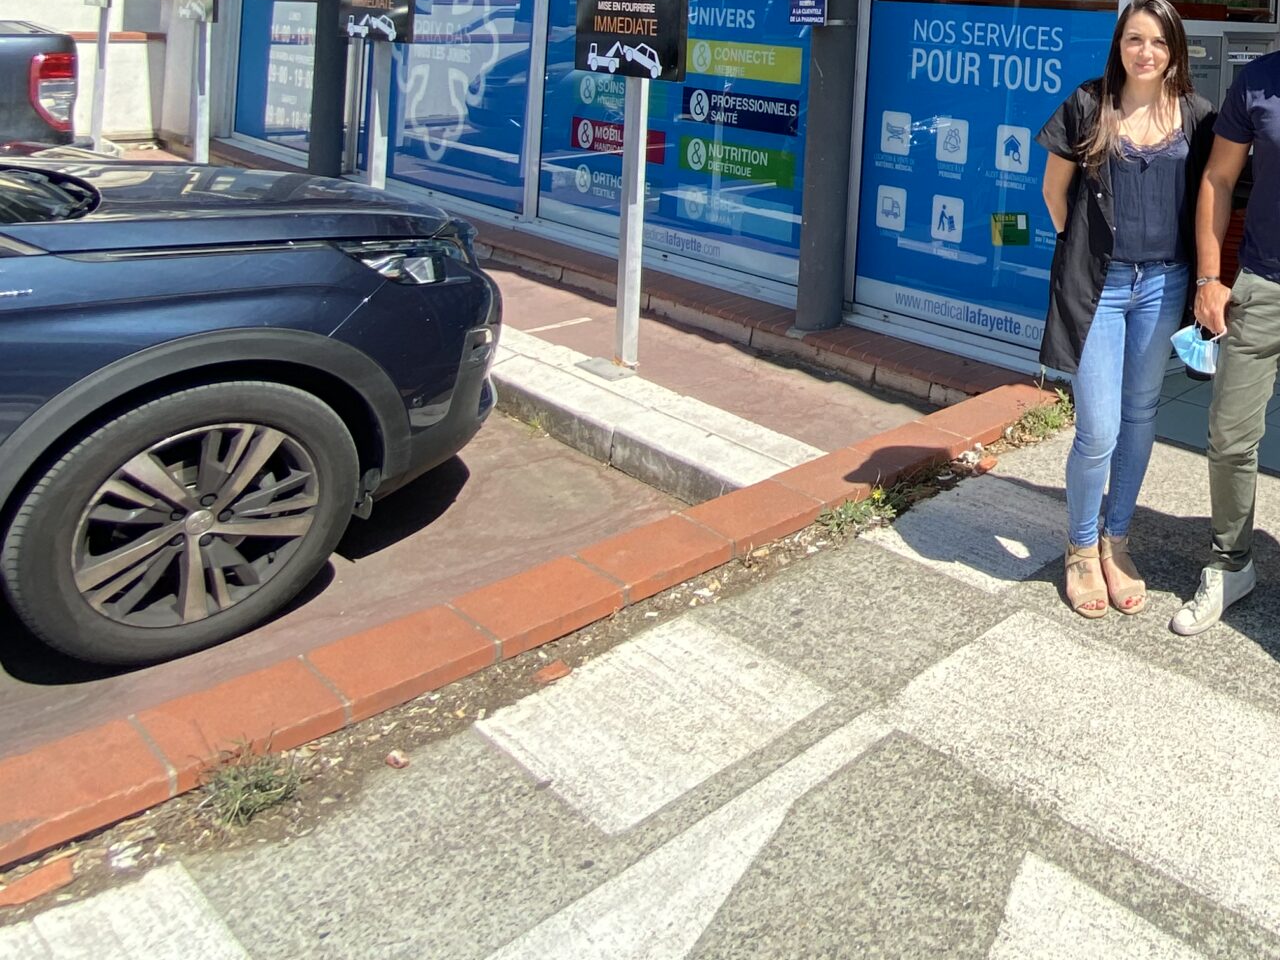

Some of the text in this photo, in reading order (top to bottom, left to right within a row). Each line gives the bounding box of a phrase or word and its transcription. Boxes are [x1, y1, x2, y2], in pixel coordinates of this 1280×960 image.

[598, 1, 656, 13] MISE EN FOURRIERE
[688, 6, 755, 29] UNIVERS
[594, 16, 658, 36] IMMEDIATE
[913, 19, 1064, 52] NOS SERVICES
[713, 45, 776, 66] CONNECTÉ
[911, 48, 1063, 94] POUR TOUS
[596, 79, 625, 94] SOINS
[710, 109, 738, 125] SANTÉ
[711, 93, 798, 118] PROFESSIONNELS
[707, 143, 768, 167] NUTRITION
[643, 229, 721, 259] edicallafayette.com
